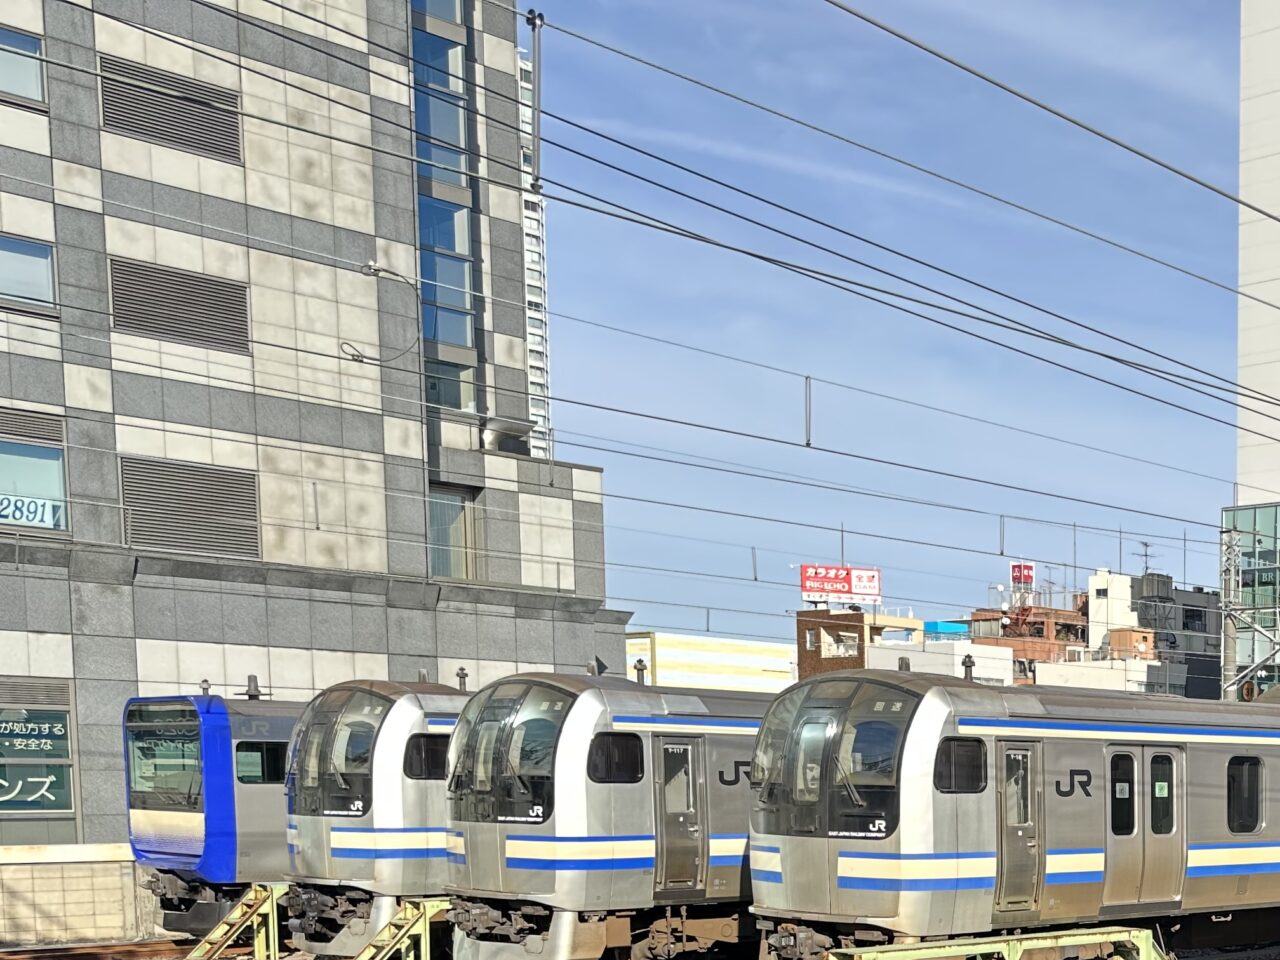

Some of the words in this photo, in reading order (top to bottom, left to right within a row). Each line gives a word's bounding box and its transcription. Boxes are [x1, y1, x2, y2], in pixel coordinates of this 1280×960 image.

[0, 497, 46, 523] 2891
[0, 722, 65, 735] が処方する
[241, 721, 270, 736] JR
[1055, 769, 1092, 797] JR
[350, 800, 363, 811] JR
[529, 805, 543, 816] JR
[869, 820, 886, 831] JR
